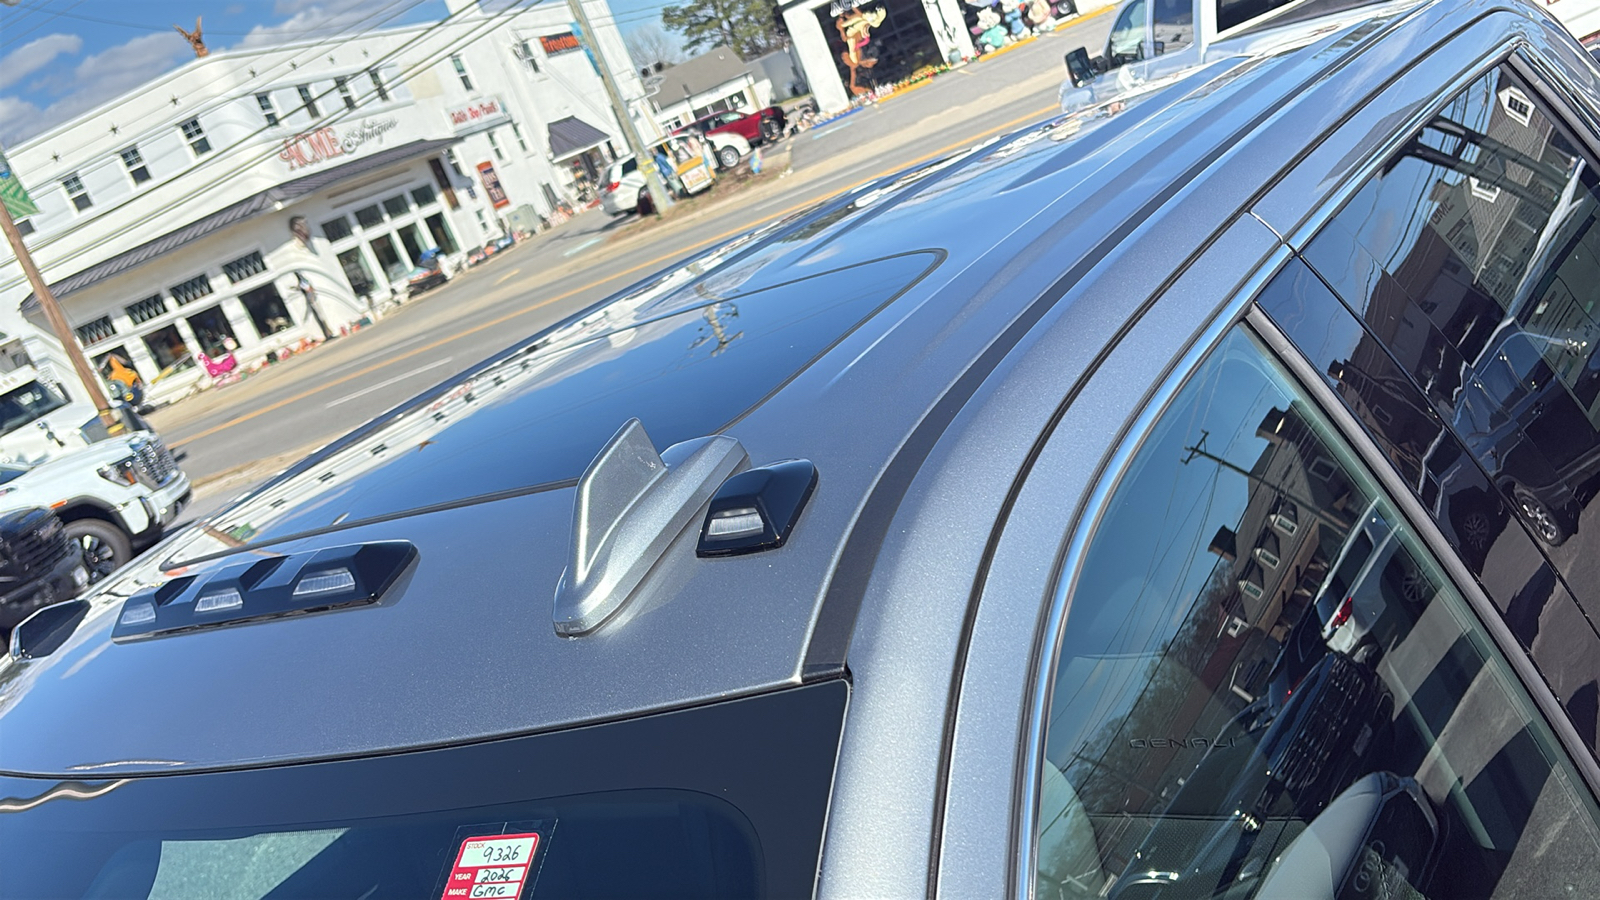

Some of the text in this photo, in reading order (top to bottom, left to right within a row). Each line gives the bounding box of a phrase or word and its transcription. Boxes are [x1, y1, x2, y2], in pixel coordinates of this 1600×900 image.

[280, 127, 345, 170] ACME
[1129, 737, 1236, 749] DENALI
[467, 842, 486, 850] STOCK
[483, 845, 521, 863] 9326
[480, 868, 514, 884] 2026
[447, 888, 468, 896] MAKE
